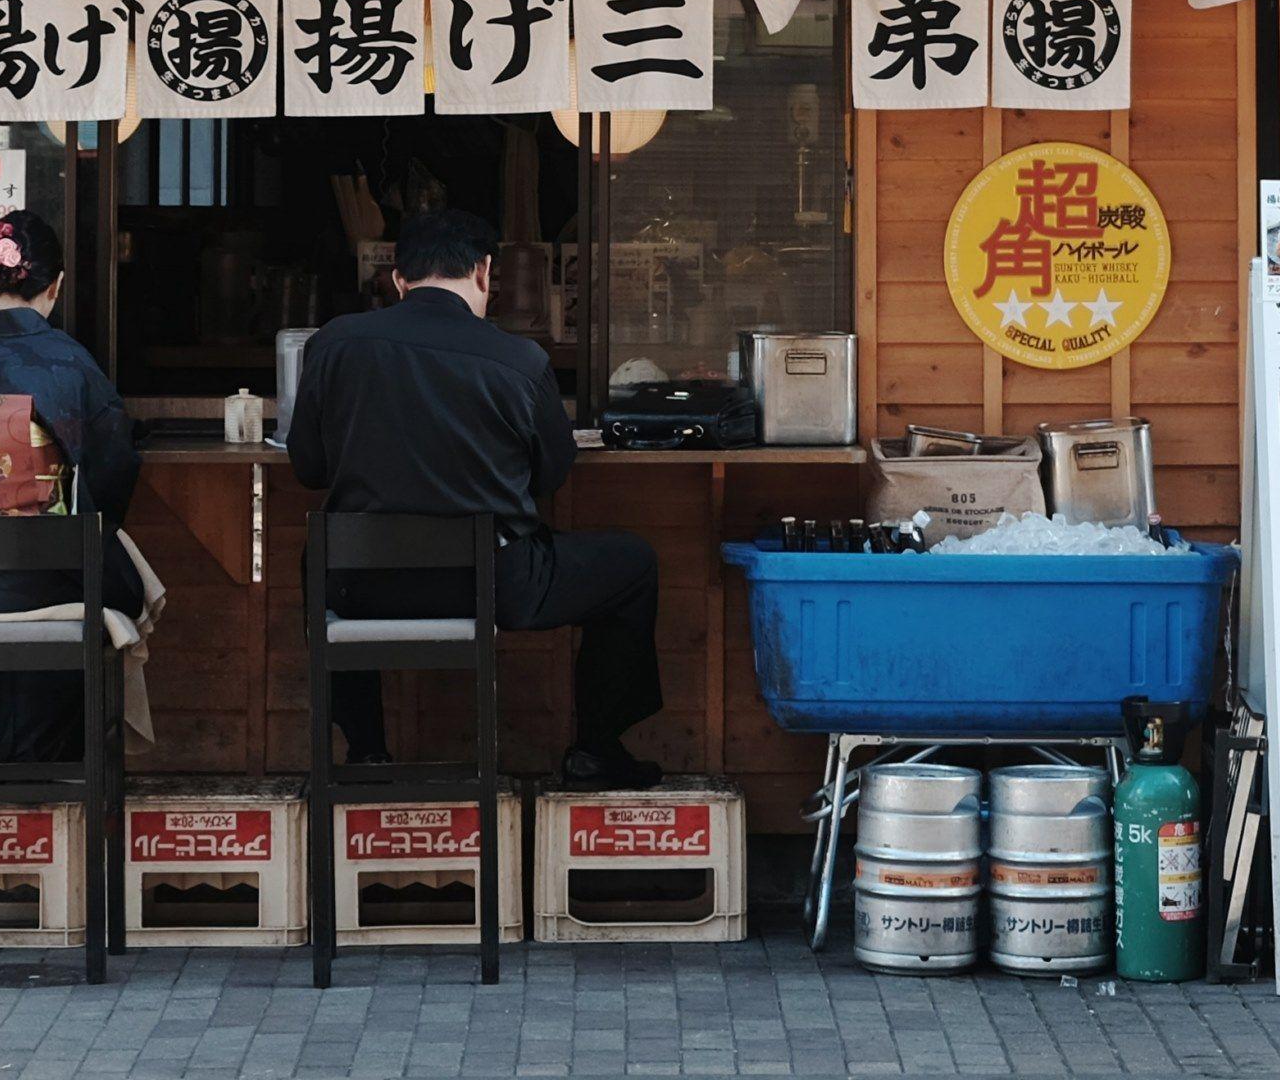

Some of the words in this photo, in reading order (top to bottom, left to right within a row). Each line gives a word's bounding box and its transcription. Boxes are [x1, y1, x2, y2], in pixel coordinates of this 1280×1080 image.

[167, 8, 243, 80] 揚
[1015, 159, 1105, 240] 超
[1097, 204, 1147, 231] 炭酸
[973, 218, 1053, 300] 角
[1052, 239, 1140, 263] ハイボール
[1053, 262, 1098, 273] SUNTORY
[1102, 262, 1140, 273] WHISKY
[1005, 325, 1056, 352] SPECIAL
[1061, 325, 1112, 352] QUALITY
[951, 493, 977, 504] 805
[134, 834, 268, 857] アサヒビール
[349, 830, 480, 855] アサヒビール
[572, 829, 707, 853] アサヒビール
